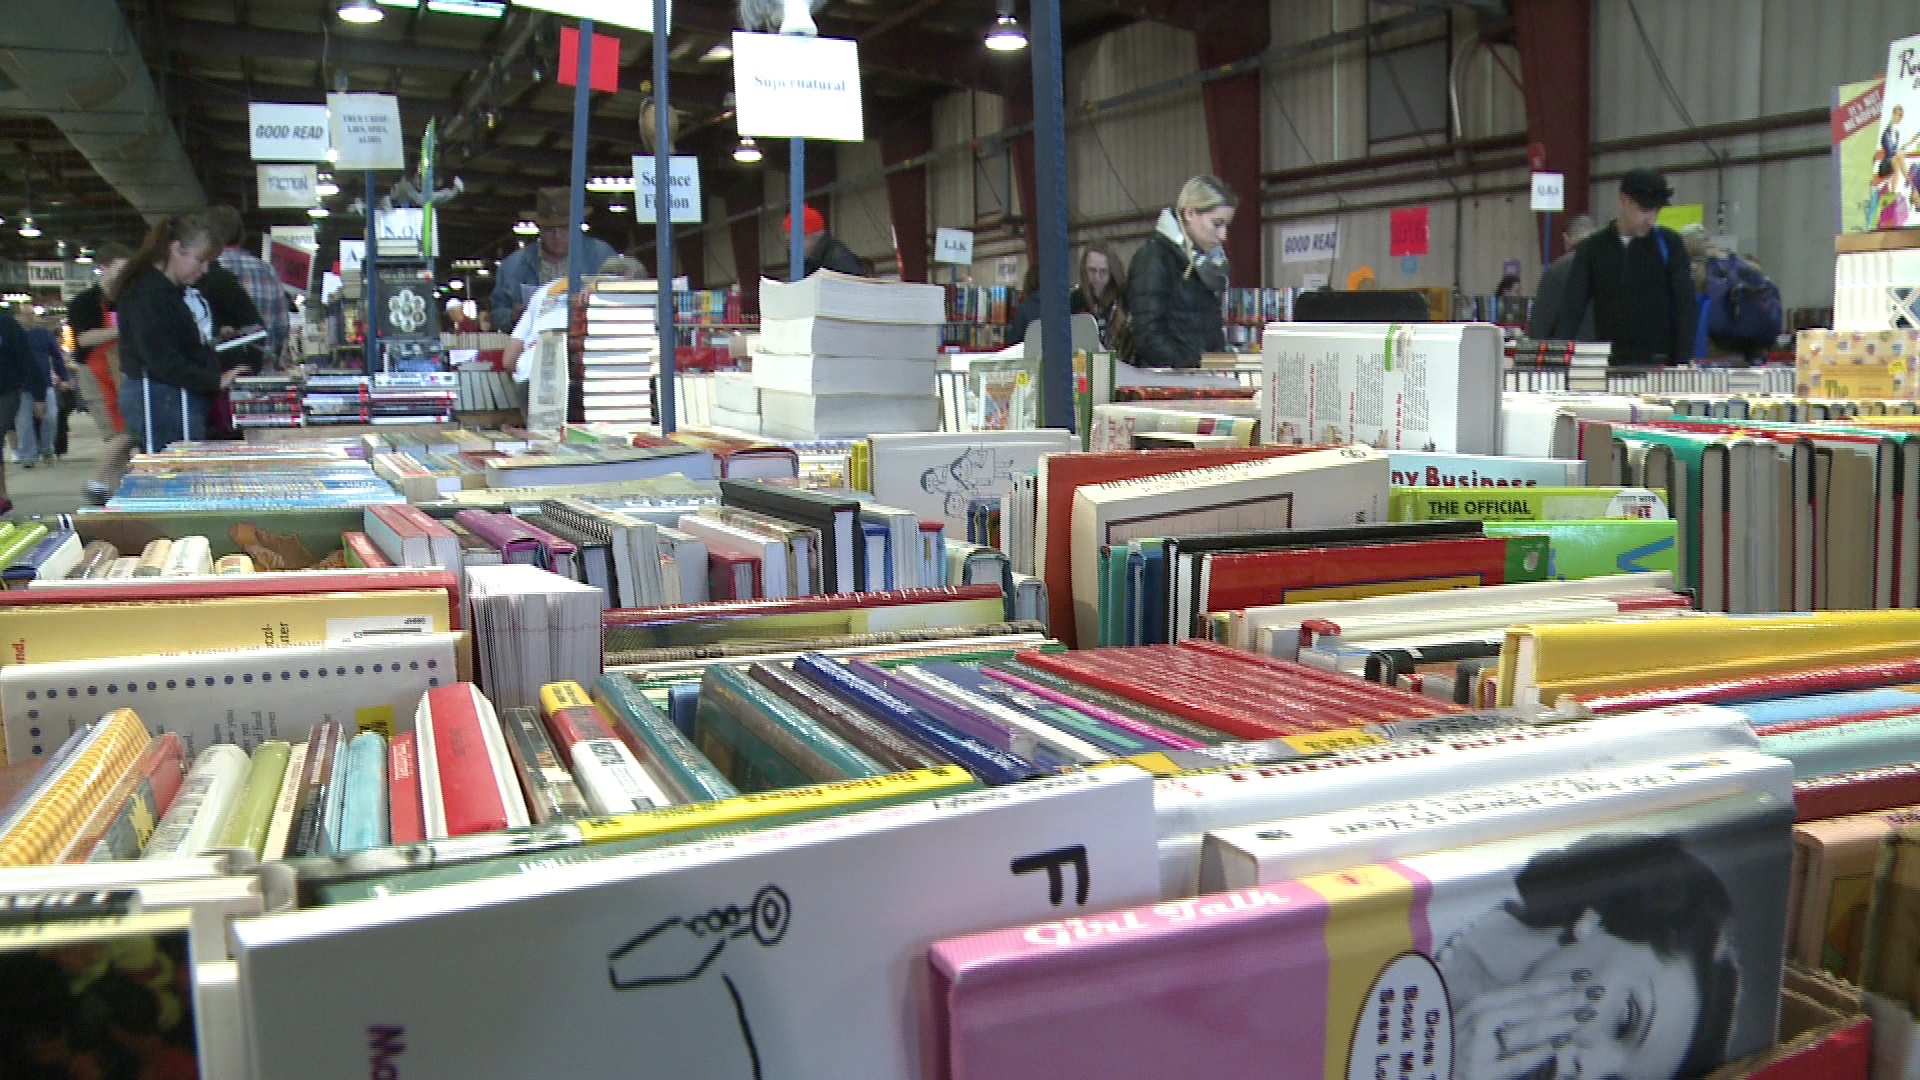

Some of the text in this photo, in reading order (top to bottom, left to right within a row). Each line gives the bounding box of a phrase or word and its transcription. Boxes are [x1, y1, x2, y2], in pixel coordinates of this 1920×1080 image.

[754, 75, 846, 92] Supernatural
[255, 125, 324, 139] GOOD READ
[1284, 231, 1337, 254] GOOD READ
[29, 265, 64, 281] TRAVEL
[1429, 500, 1459, 515] THE
[1464, 499, 1532, 515] OFFICIAL
[1023, 890, 1291, 945] Girl Talk
[1402, 984, 1419, 1041] Book
[1423, 1008, 1440, 1066] Does
